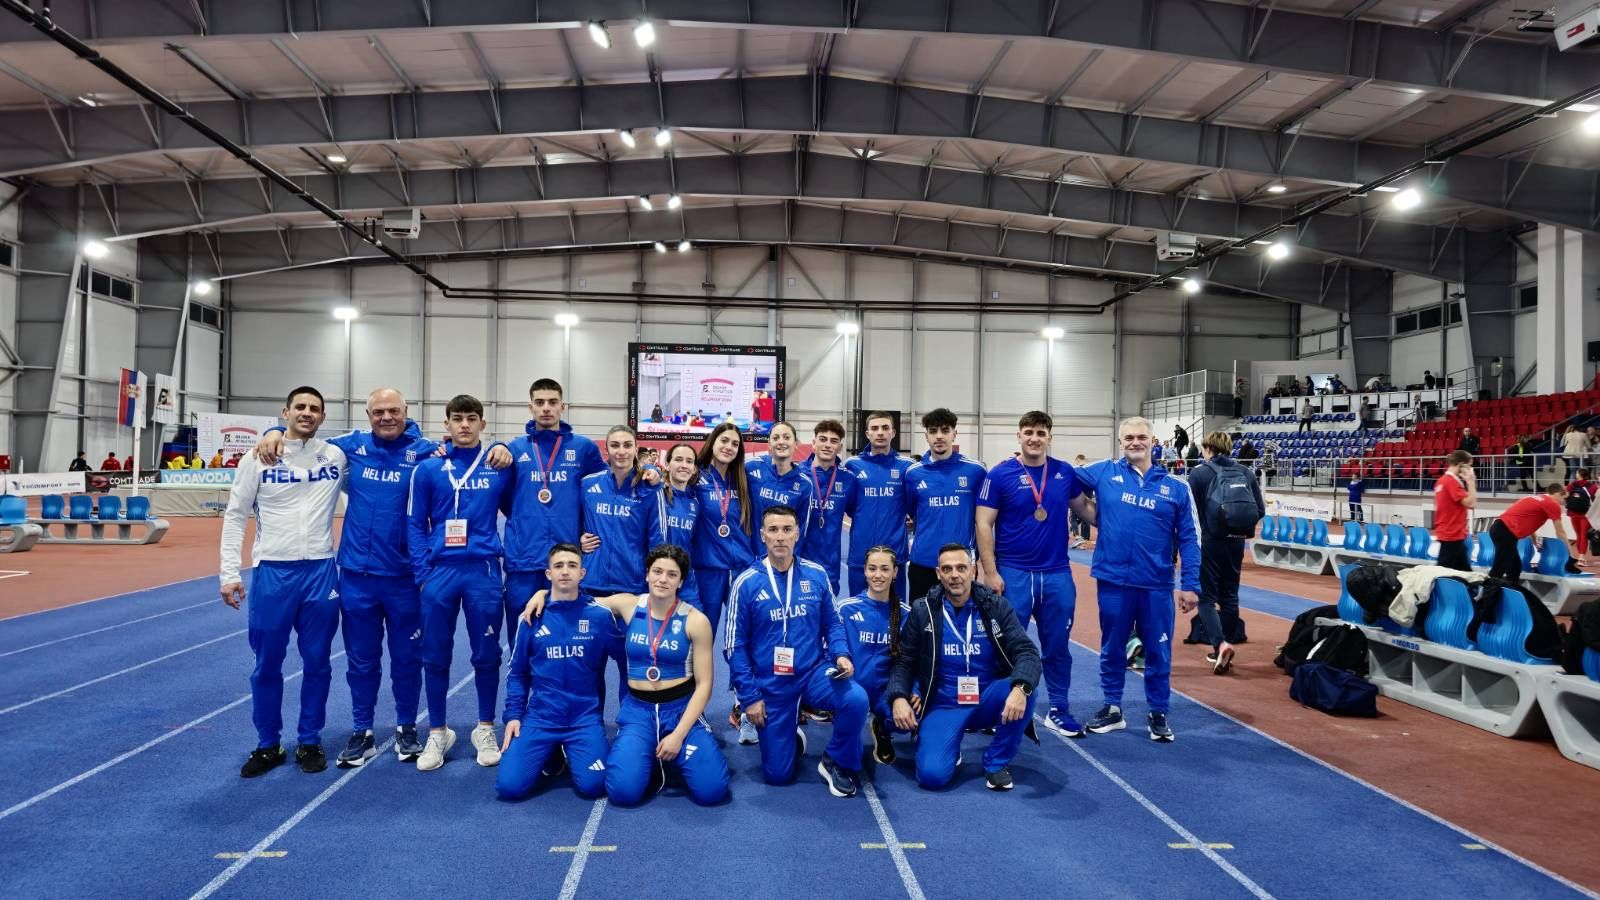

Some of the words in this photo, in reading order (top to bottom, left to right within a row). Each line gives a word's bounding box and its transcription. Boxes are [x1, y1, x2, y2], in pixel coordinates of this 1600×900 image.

[109, 476, 156, 485] COMTADE
[164, 472, 232, 484] VODAVODA
[262, 465, 340, 484] HELLAS
[362, 467, 401, 483] HELLAS
[531, 471, 567, 482] HLAS
[759, 487, 789, 505] HELLAS
[864, 487, 894, 497] HELLAS
[929, 496, 959, 507] HELLAS
[1121, 491, 1156, 510] HELLAS
[596, 503, 631, 517] HELLAS
[666, 515, 694, 530] HELLAS
[546, 645, 584, 659] HELLAS
